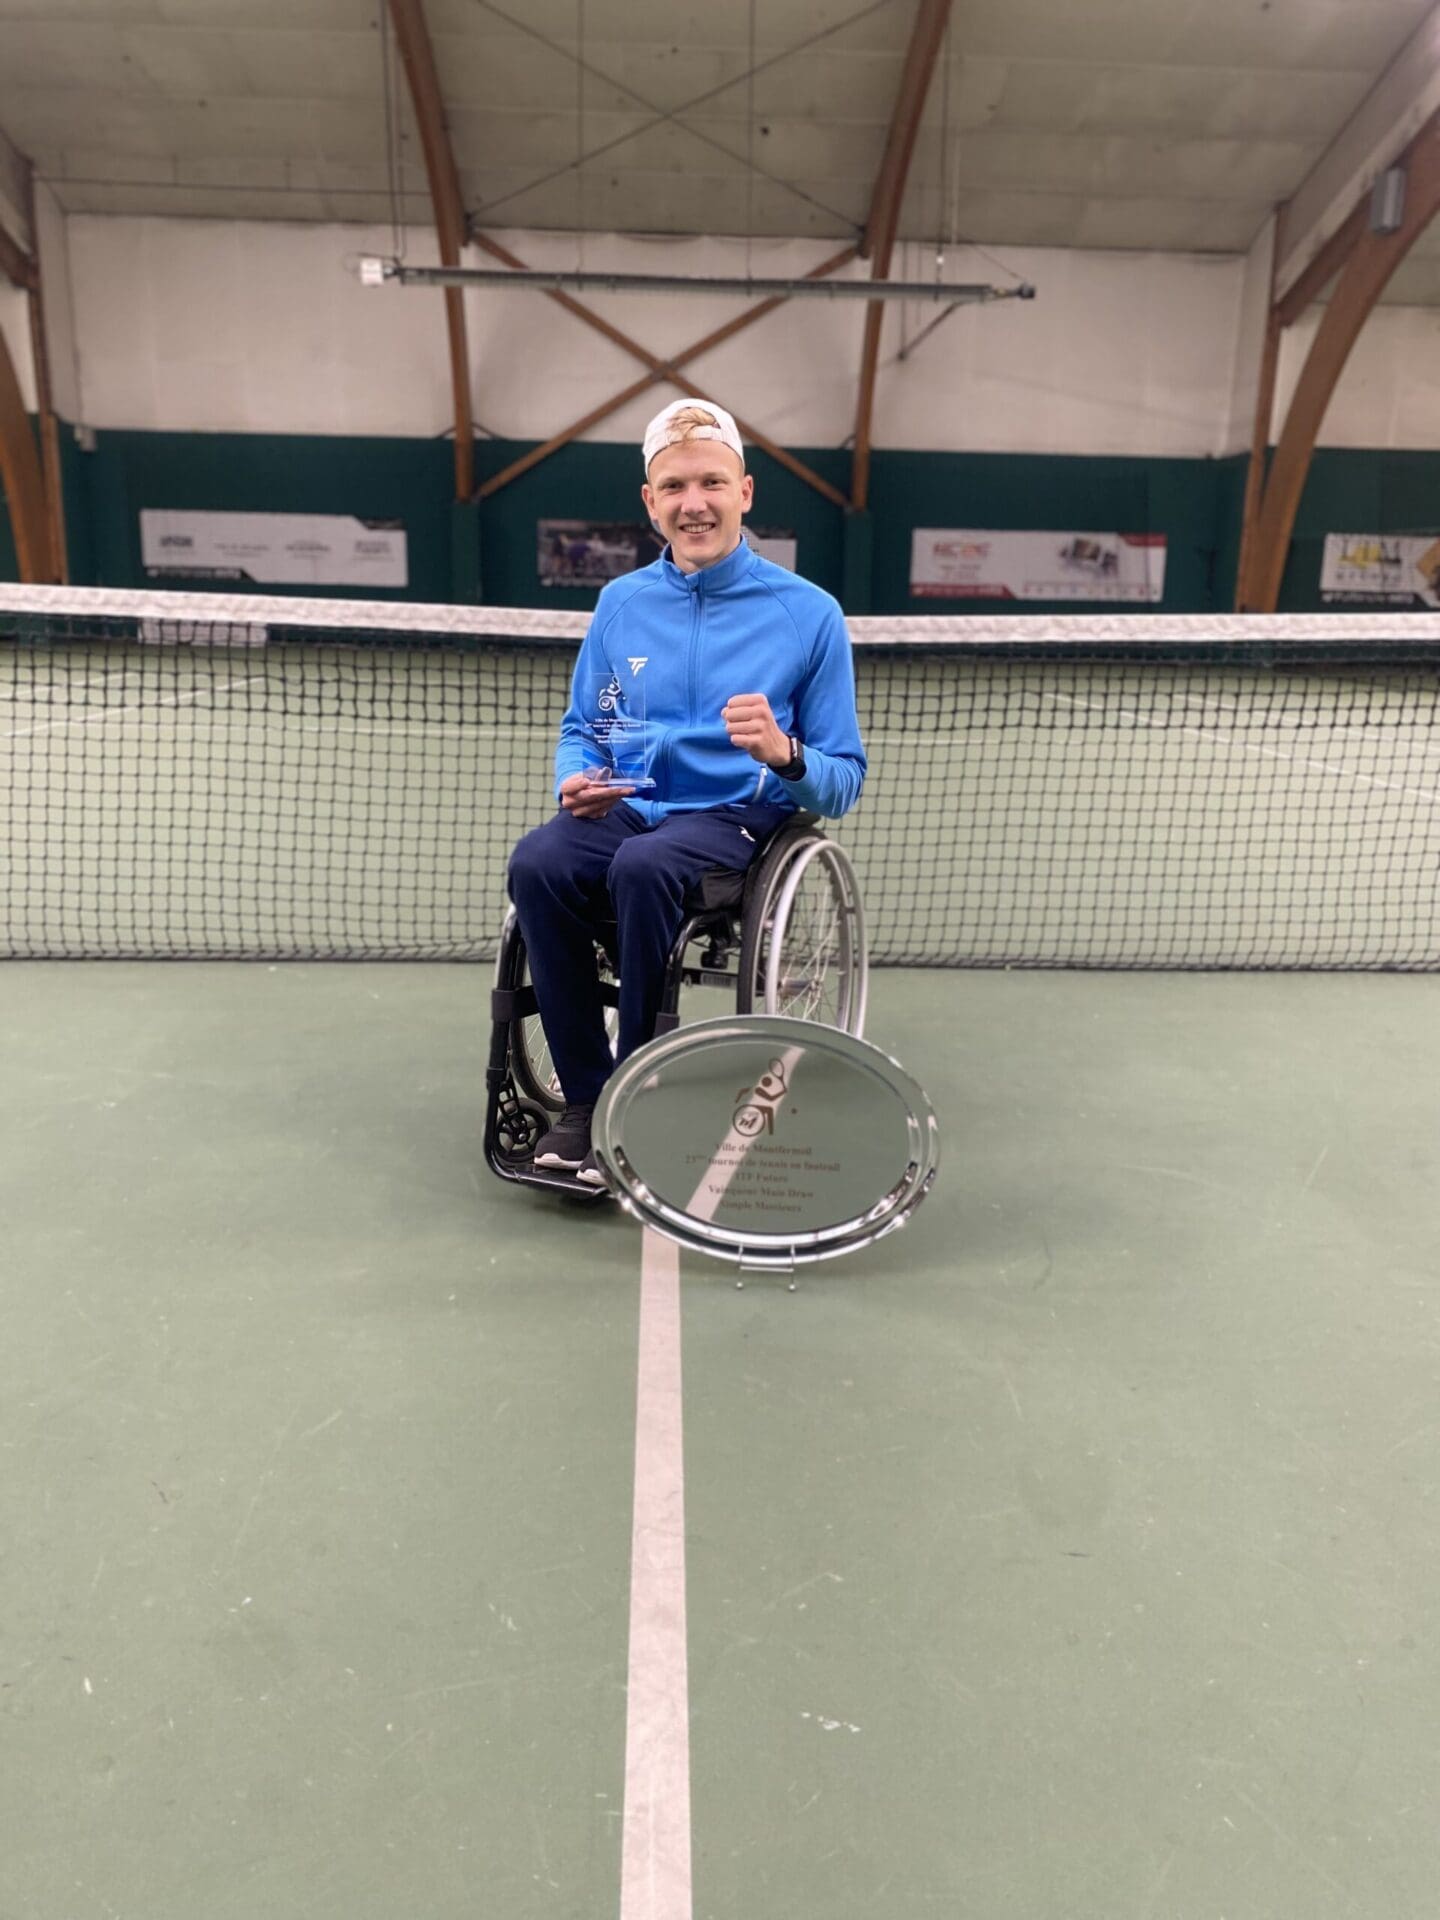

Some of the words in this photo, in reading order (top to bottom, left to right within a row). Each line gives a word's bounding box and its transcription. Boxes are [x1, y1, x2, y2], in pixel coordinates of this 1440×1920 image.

[715, 1143, 737, 1151] Ville
[738, 1143, 750, 1152] de
[745, 1159, 757, 1167] de
[759, 1160, 788, 1169] tennis
